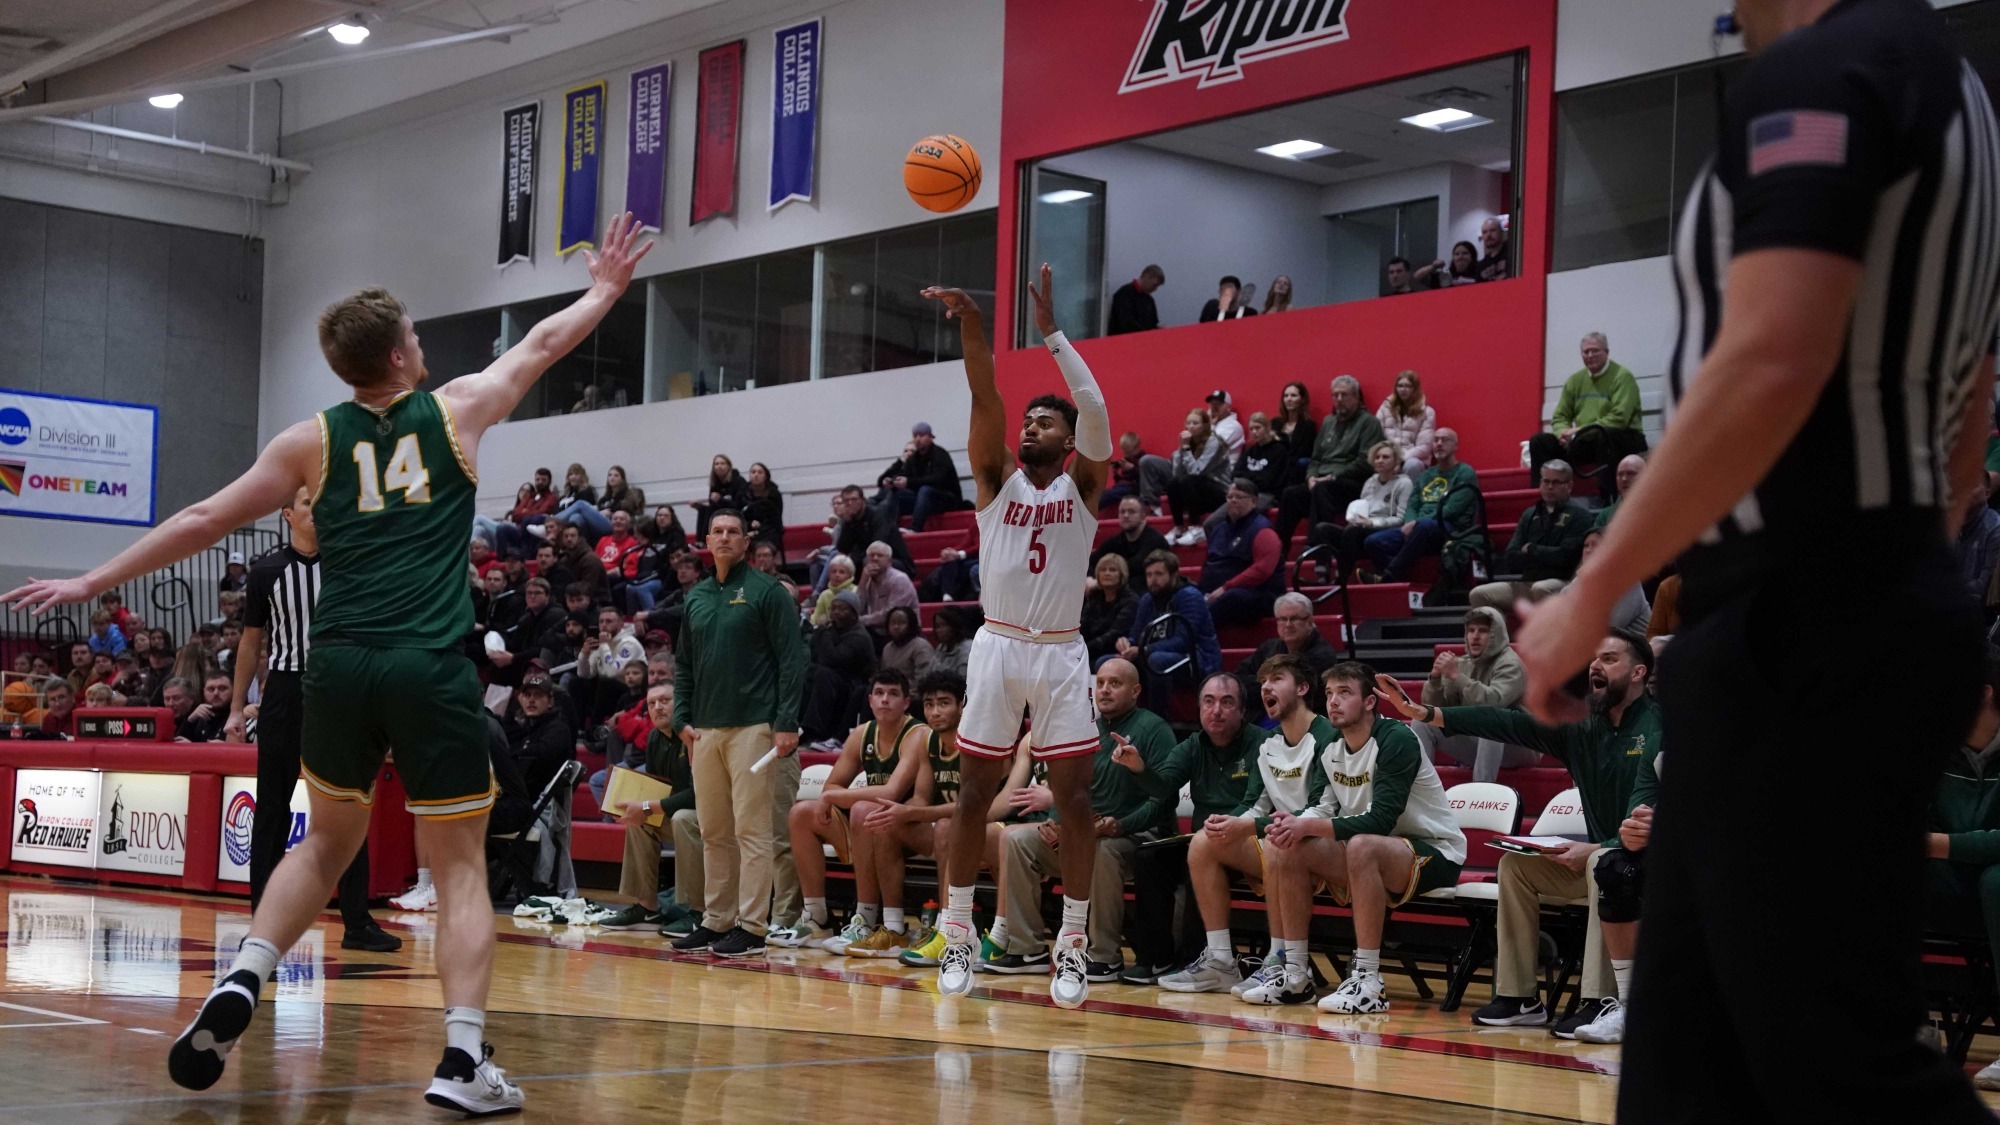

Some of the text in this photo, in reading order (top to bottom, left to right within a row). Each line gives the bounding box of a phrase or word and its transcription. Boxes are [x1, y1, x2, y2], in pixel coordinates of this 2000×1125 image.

[782, 35, 797, 117] COLLEGE
[796, 30, 811, 114] ILLINOIS
[572, 96, 584, 172] COLLEGE
[584, 94, 597, 155] BELOIT
[635, 76, 649, 154] COLLEGE
[648, 73, 662, 154] CORNELL
[508, 114, 520, 222] CONFERENCE
[520, 111, 533, 195] MIDWEST
[39, 426, 116, 448] Division III
[28, 474, 127, 497] ONETEAM
[353, 432, 431, 512] 14
[1003, 501, 1034, 526] RED
[1028, 528, 1047, 574] 5
[108, 721, 123, 735] POSS
[29, 786, 85, 798] HOME OF THE
[1469, 800, 1510, 811] HAWKS
[1549, 805, 1574, 815] RED
[38, 816, 93, 827] RIPON COLLEGE
[128, 811, 188, 852] RIPON
[138, 853, 174, 866] COLLEGE
